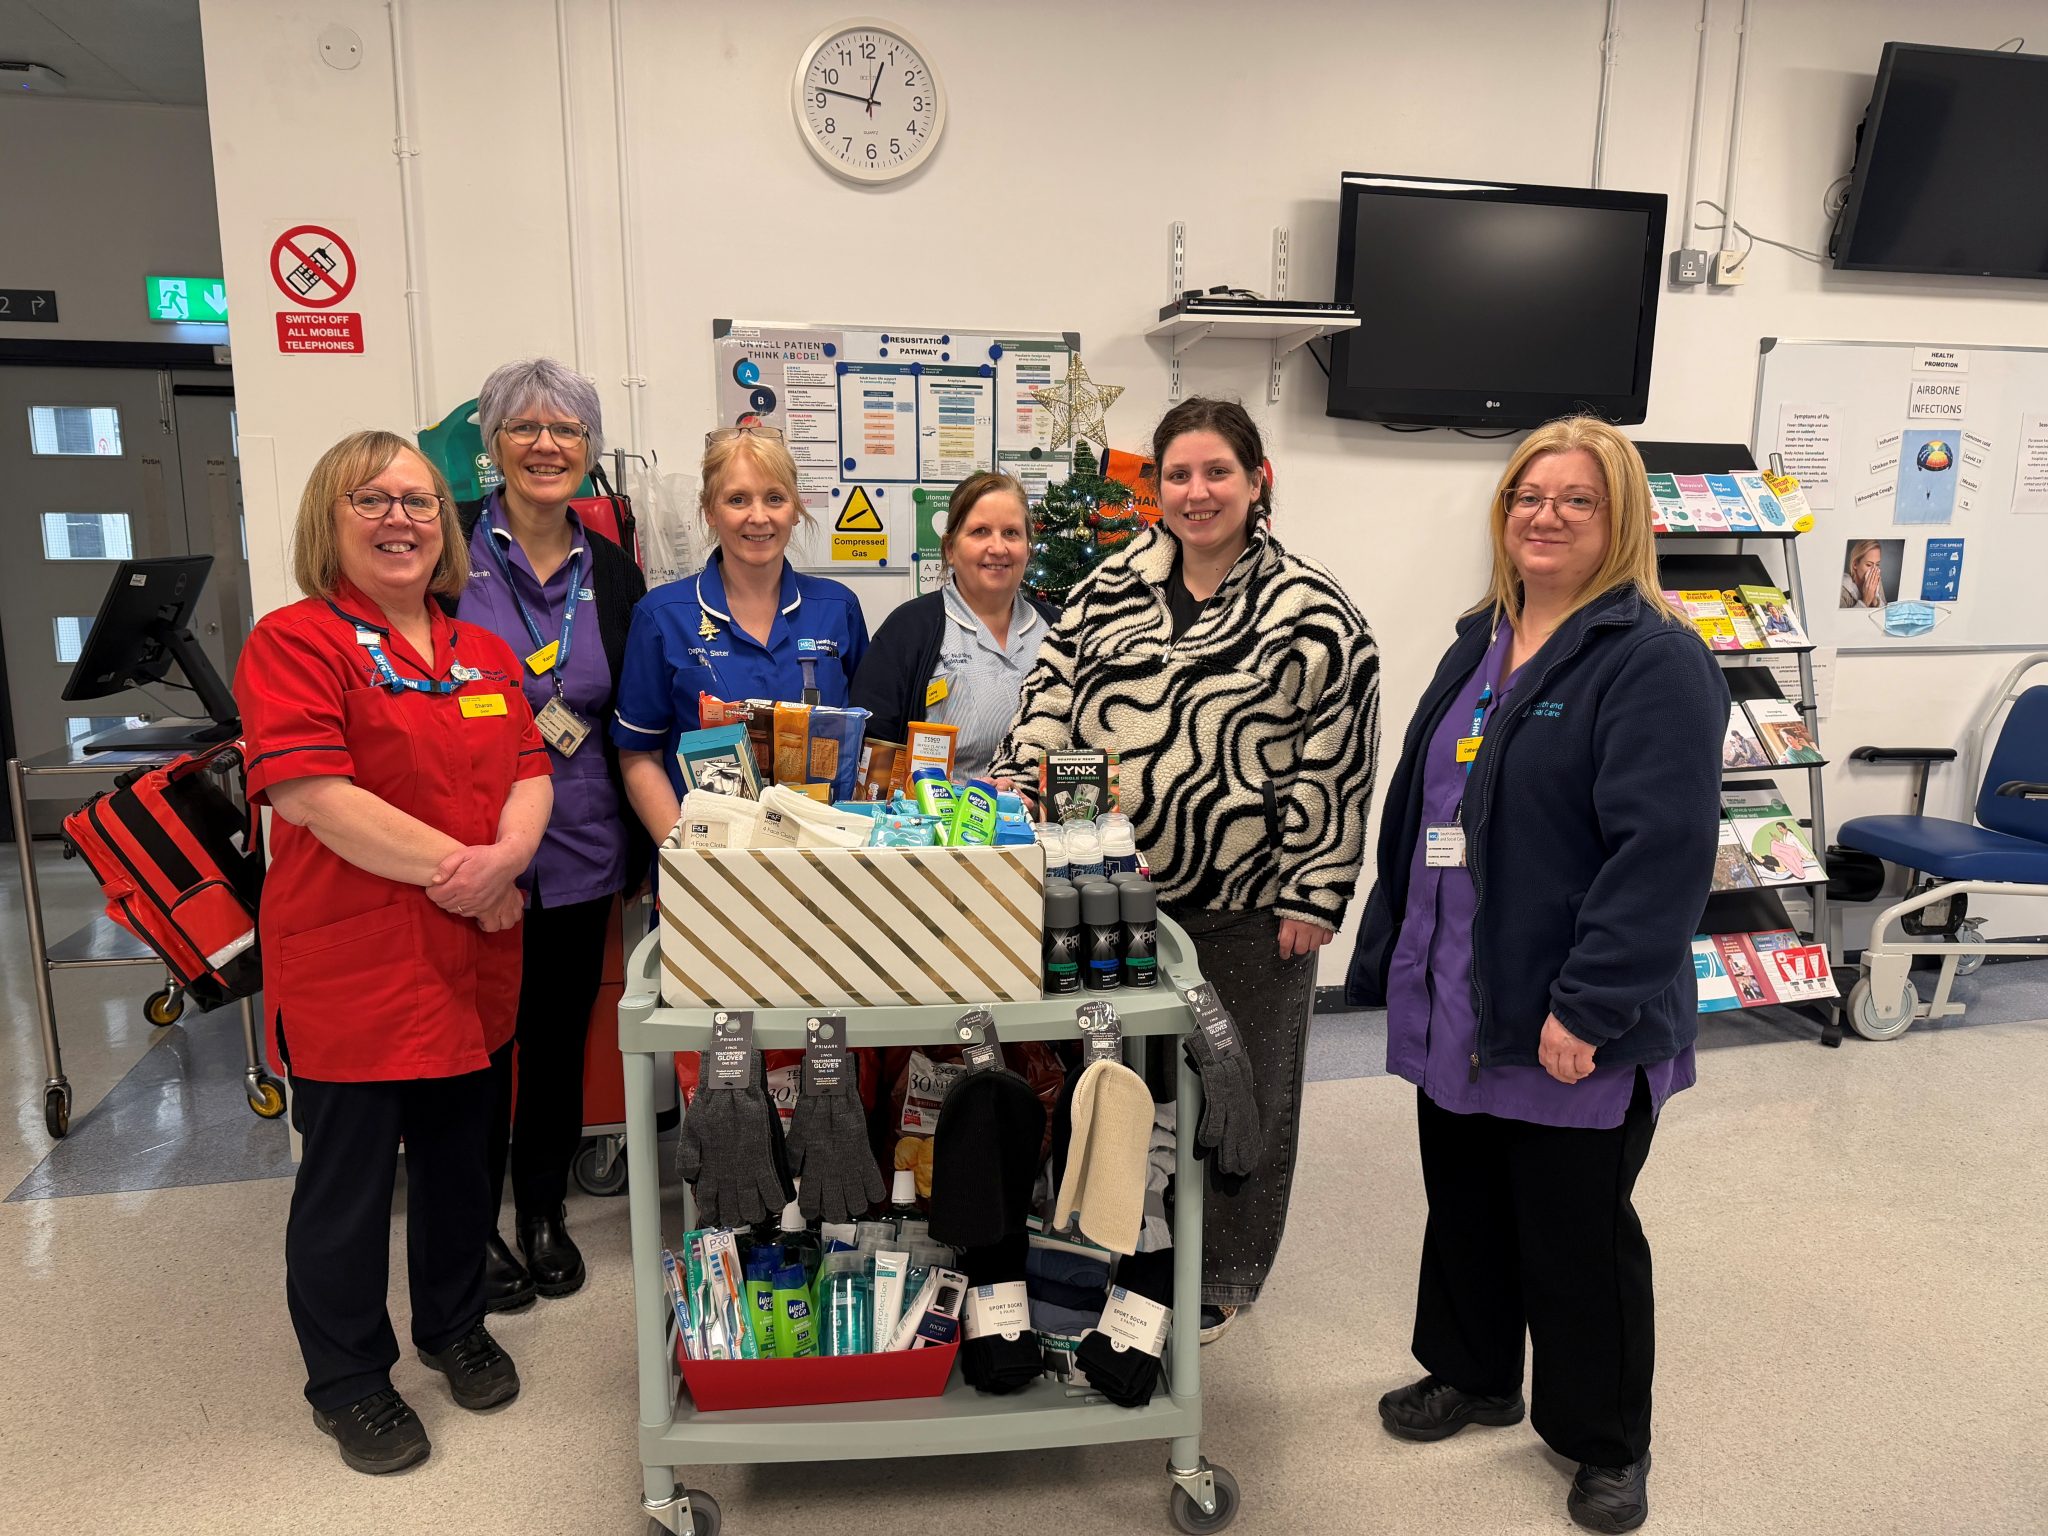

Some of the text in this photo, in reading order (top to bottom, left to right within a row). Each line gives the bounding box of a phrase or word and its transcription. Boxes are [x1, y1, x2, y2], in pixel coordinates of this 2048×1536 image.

[859, 43, 876, 59] 12
[838, 50, 852, 66] 11
[888, 50, 894, 66] 1
[821, 68, 839, 85] 10
[904, 70, 915, 87] 2
[815, 92, 827, 109] 9
[912, 96, 923, 112] 3
[824, 117, 836, 134] 8
[906, 119, 917, 135] 4
[842, 136, 853, 153] 7
[889, 138, 900, 154] 5
[866, 143, 877, 160] 6
[0, 296, 11, 313] 2
[285, 315, 349, 324] SWITCH OFF
[288, 328, 350, 337] ALL MOBILE
[285, 341, 355, 350] TELEPHONES
[739, 339, 781, 349] UNWELL
[747, 350, 819, 360] THINK ABCDE!
[899, 348, 938, 356] PATHWAY
[1916, 385, 1960, 395] AIRBORNE
[757, 396, 765, 405] B
[1912, 404, 1962, 414] INFECTIONS
[1964, 432, 1982, 444] Common
[1965, 453, 1976, 462] Covid
[1871, 461, 1889, 471] Chicken
[478, 475, 499, 484] First
[1857, 485, 1894, 502] Whooping Cough
[834, 537, 885, 546] Compressed
[924, 563, 932, 572] A
[468, 569, 491, 578] Admin
[542, 653, 555, 662] Karen
[1549, 702, 1564, 710] and
[1543, 709, 1561, 718] Care
[1471, 717, 1481, 736] NHS
[1056, 765, 1097, 775] LYNX
[969, 795, 987, 805] Wash
[766, 811, 781, 822] F&F
[764, 819, 780, 828] HOME
[767, 827, 780, 835] Face
[780, 831, 796, 841] Cloths
[1209, 1024, 1228, 1035] GLOVES
[931, 1065, 959, 1076] TESCO
[910, 1072, 931, 1092] 30
[788, 1302, 806, 1314] Wash
[879, 1281, 888, 1326] protection
[1113, 1308, 1148, 1327] SPORT SOCKS
[1123, 1318, 1135, 1327] PAIRS
[929, 1323, 947, 1332] POCKET
[1041, 1337, 1070, 1349] TRUNKS
